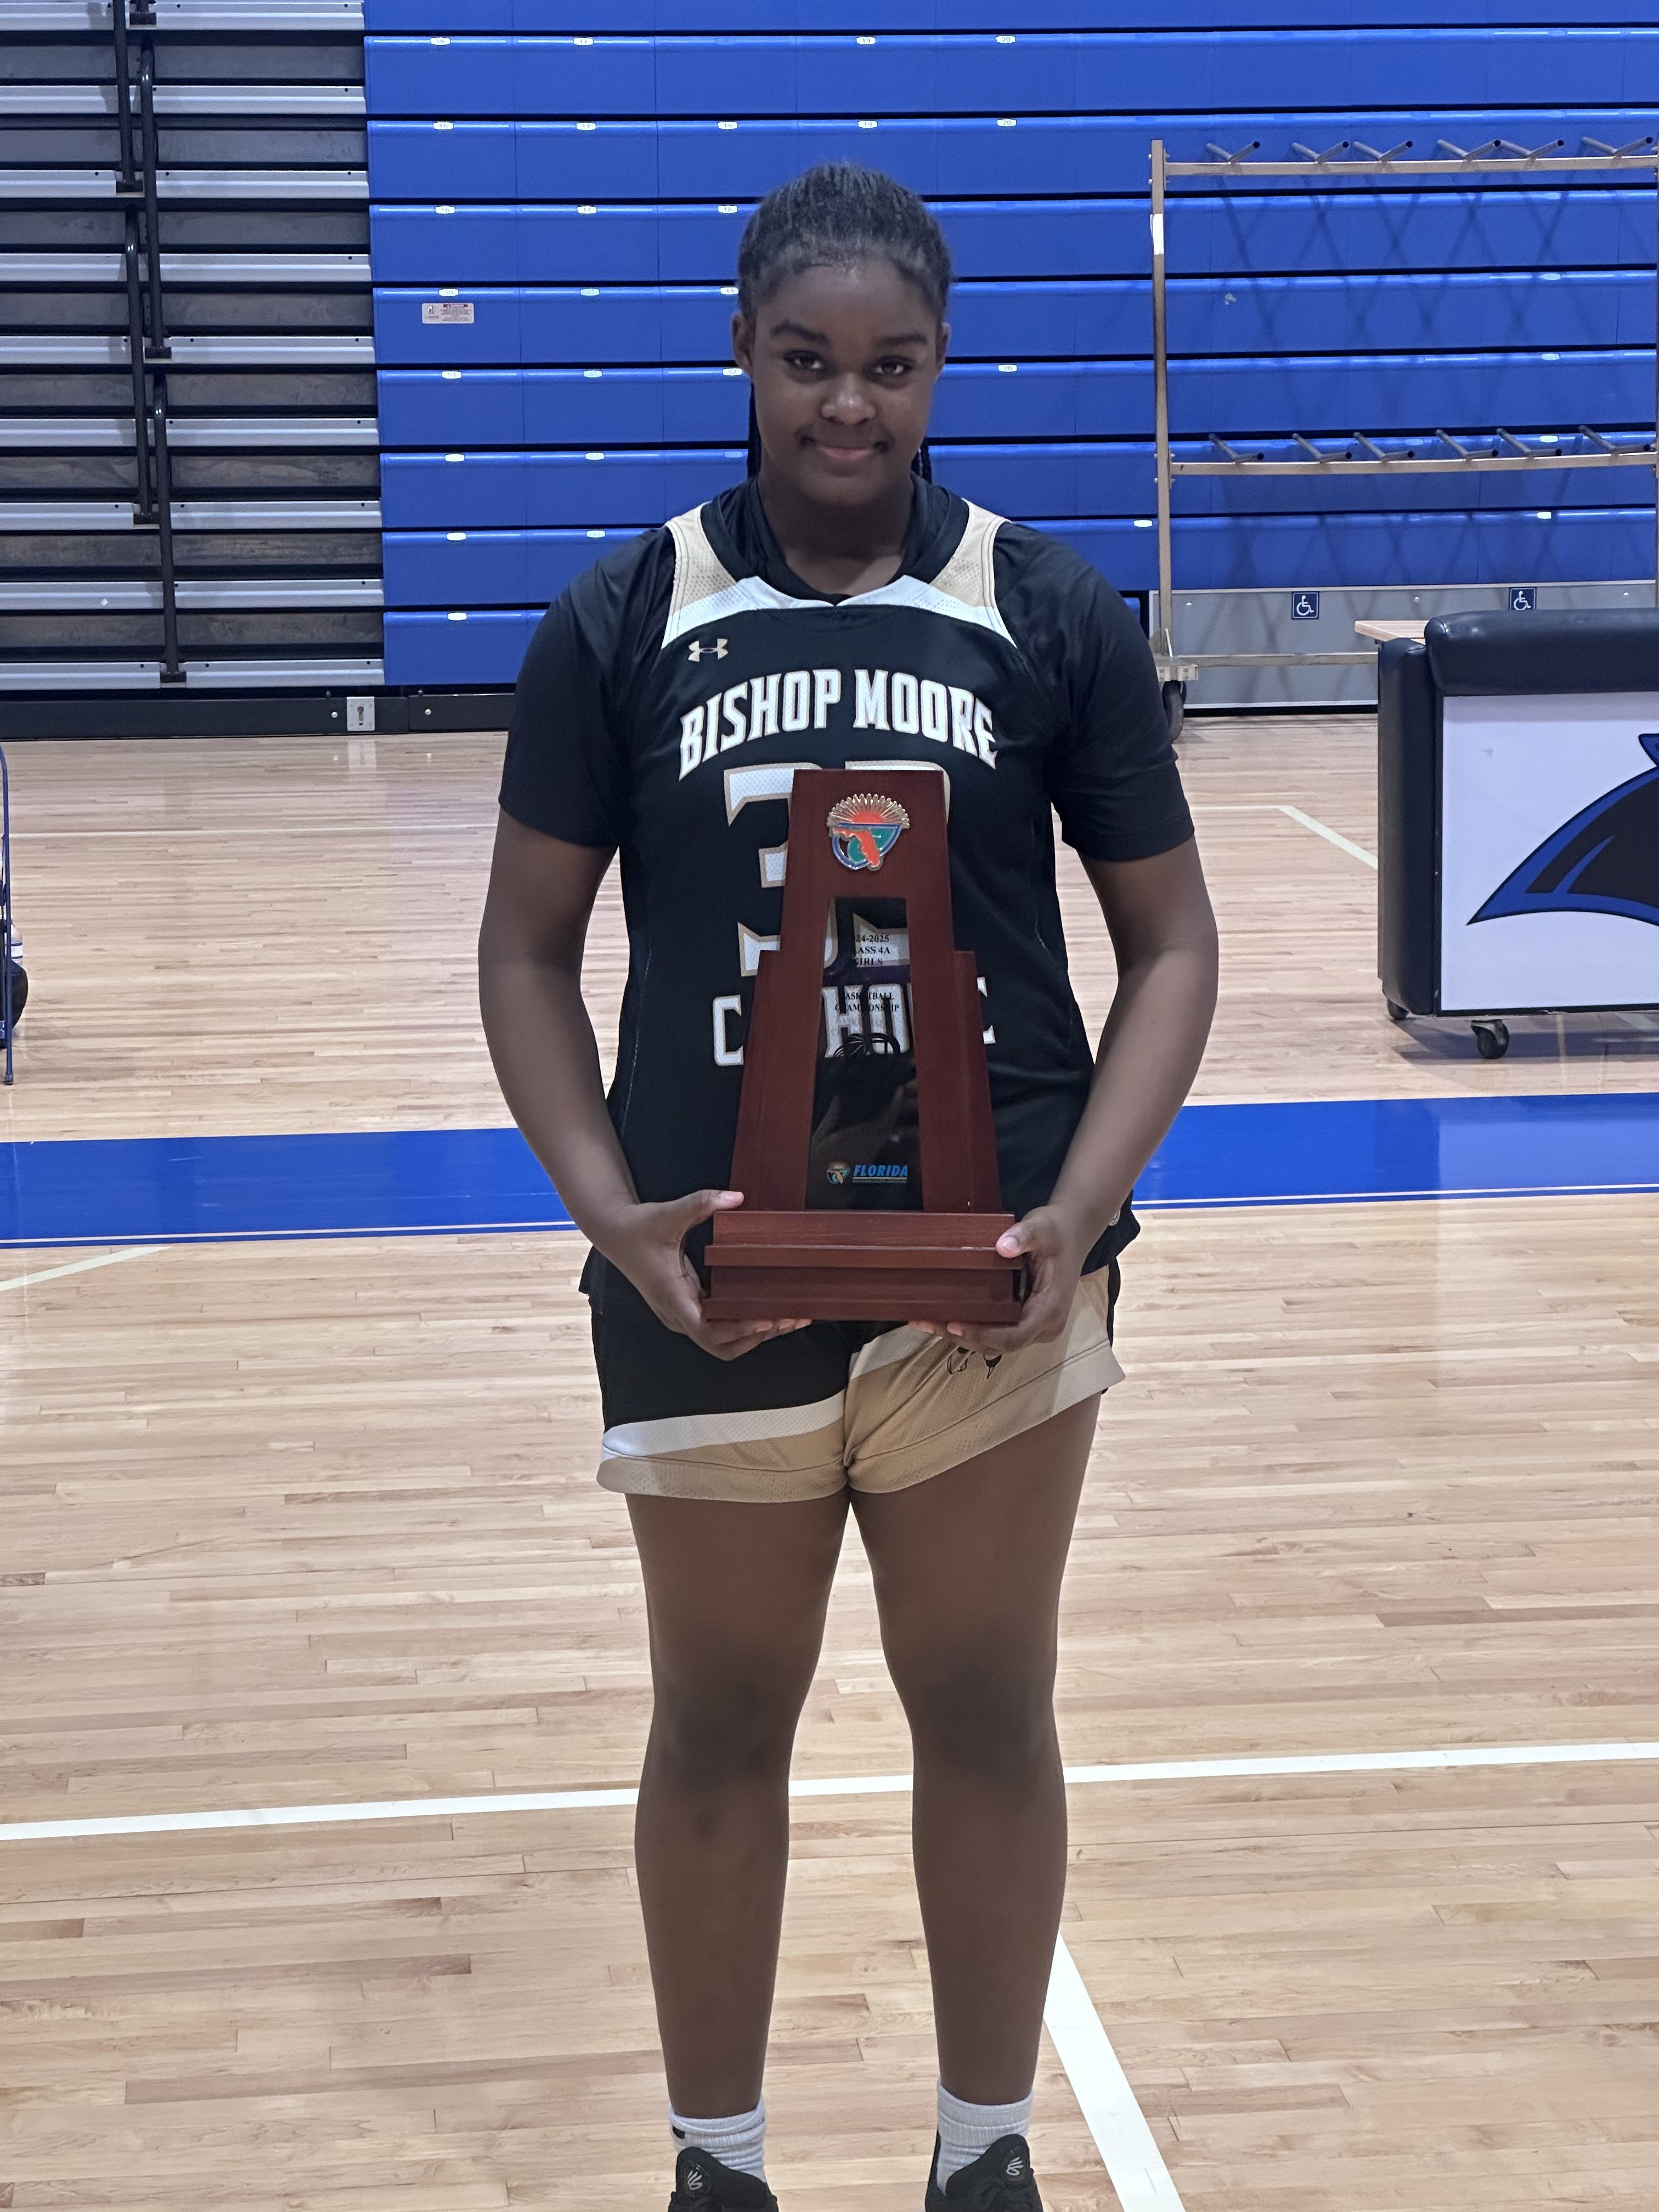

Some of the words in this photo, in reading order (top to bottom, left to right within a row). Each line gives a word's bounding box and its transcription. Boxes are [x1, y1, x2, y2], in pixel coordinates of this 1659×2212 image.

[679, 669, 841, 781] BISHOP
[853, 669, 998, 770] MOORE
[848, 934, 889, 943] 24-2025
[840, 992, 895, 1000] ASKTBALL
[853, 1164, 909, 1177] FLORIDA
